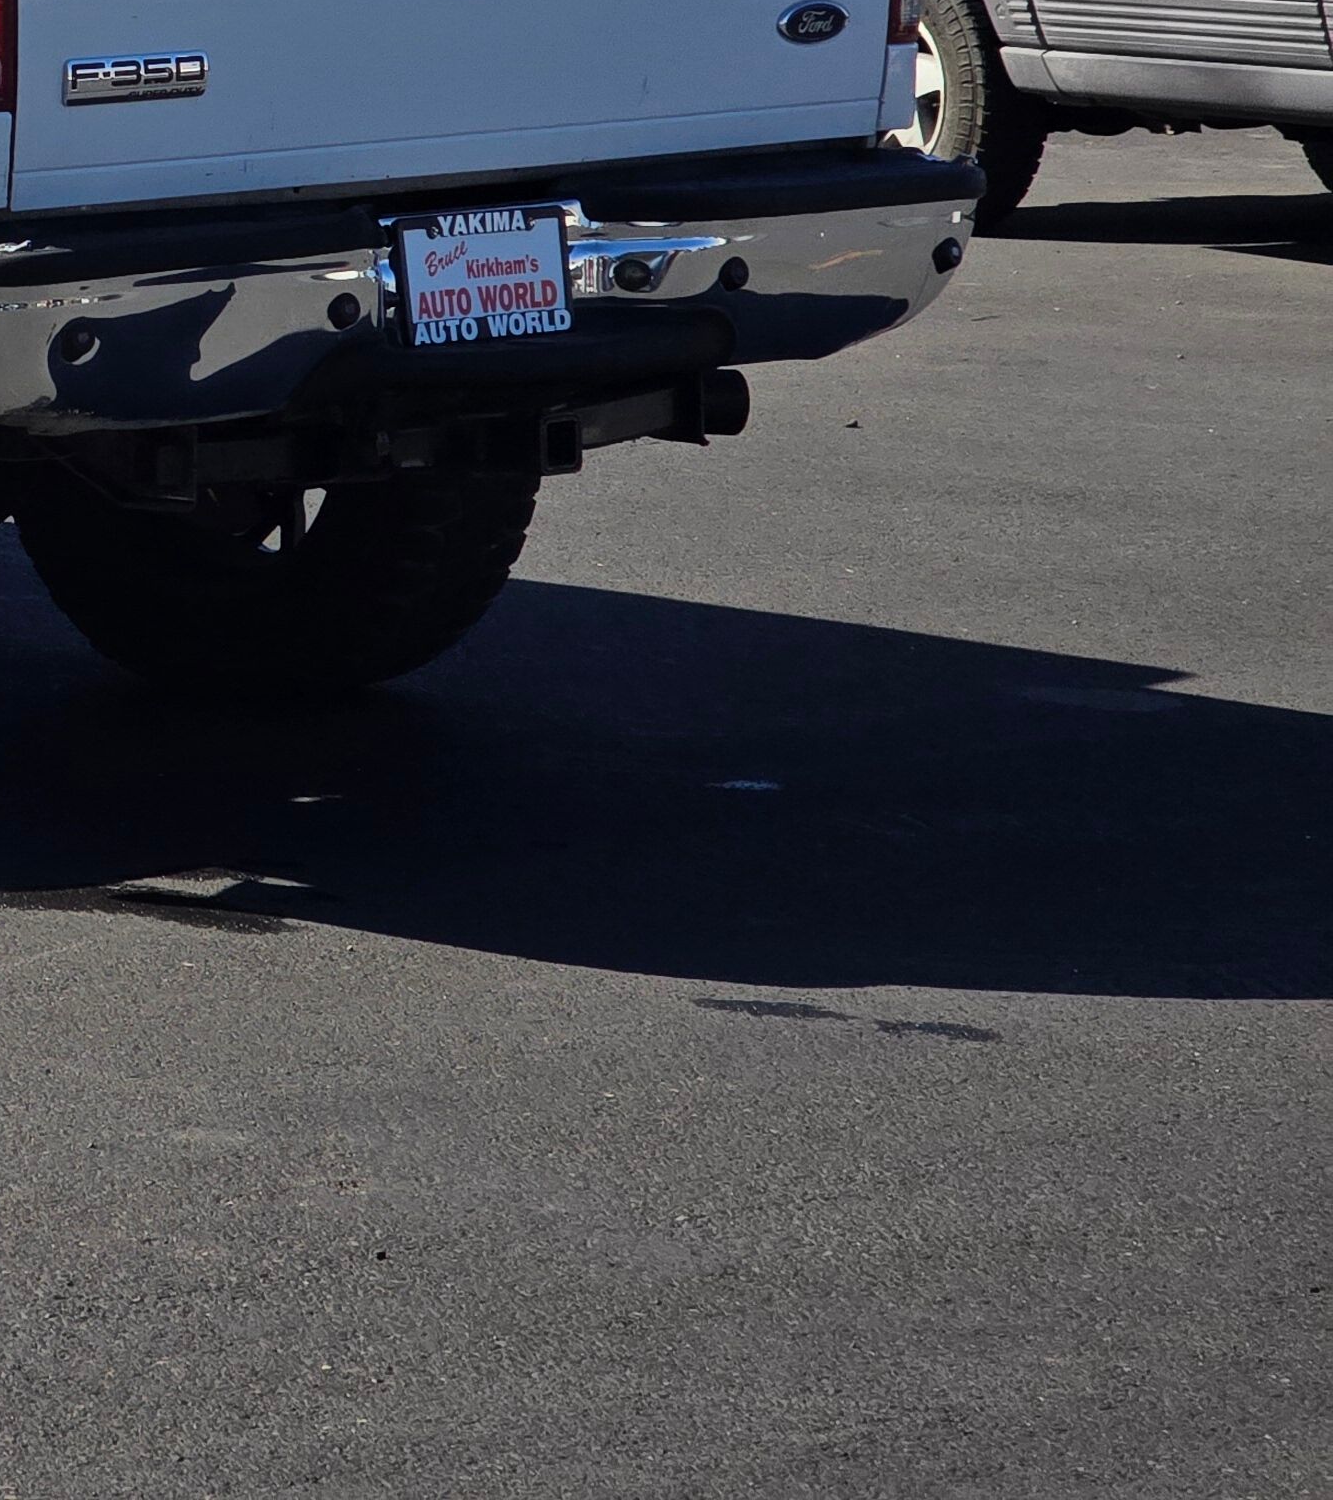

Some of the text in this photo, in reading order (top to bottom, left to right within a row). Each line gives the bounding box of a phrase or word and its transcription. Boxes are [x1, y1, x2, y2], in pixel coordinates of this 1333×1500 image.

[798, 10, 834, 33] Ford
[437, 210, 526, 237] YAKIMA
[425, 241, 468, 277] Bruce
[466, 255, 539, 279] Kirkham's
[418, 280, 558, 320] AUTO WORLD
[414, 309, 572, 346] AUTO WORLD
